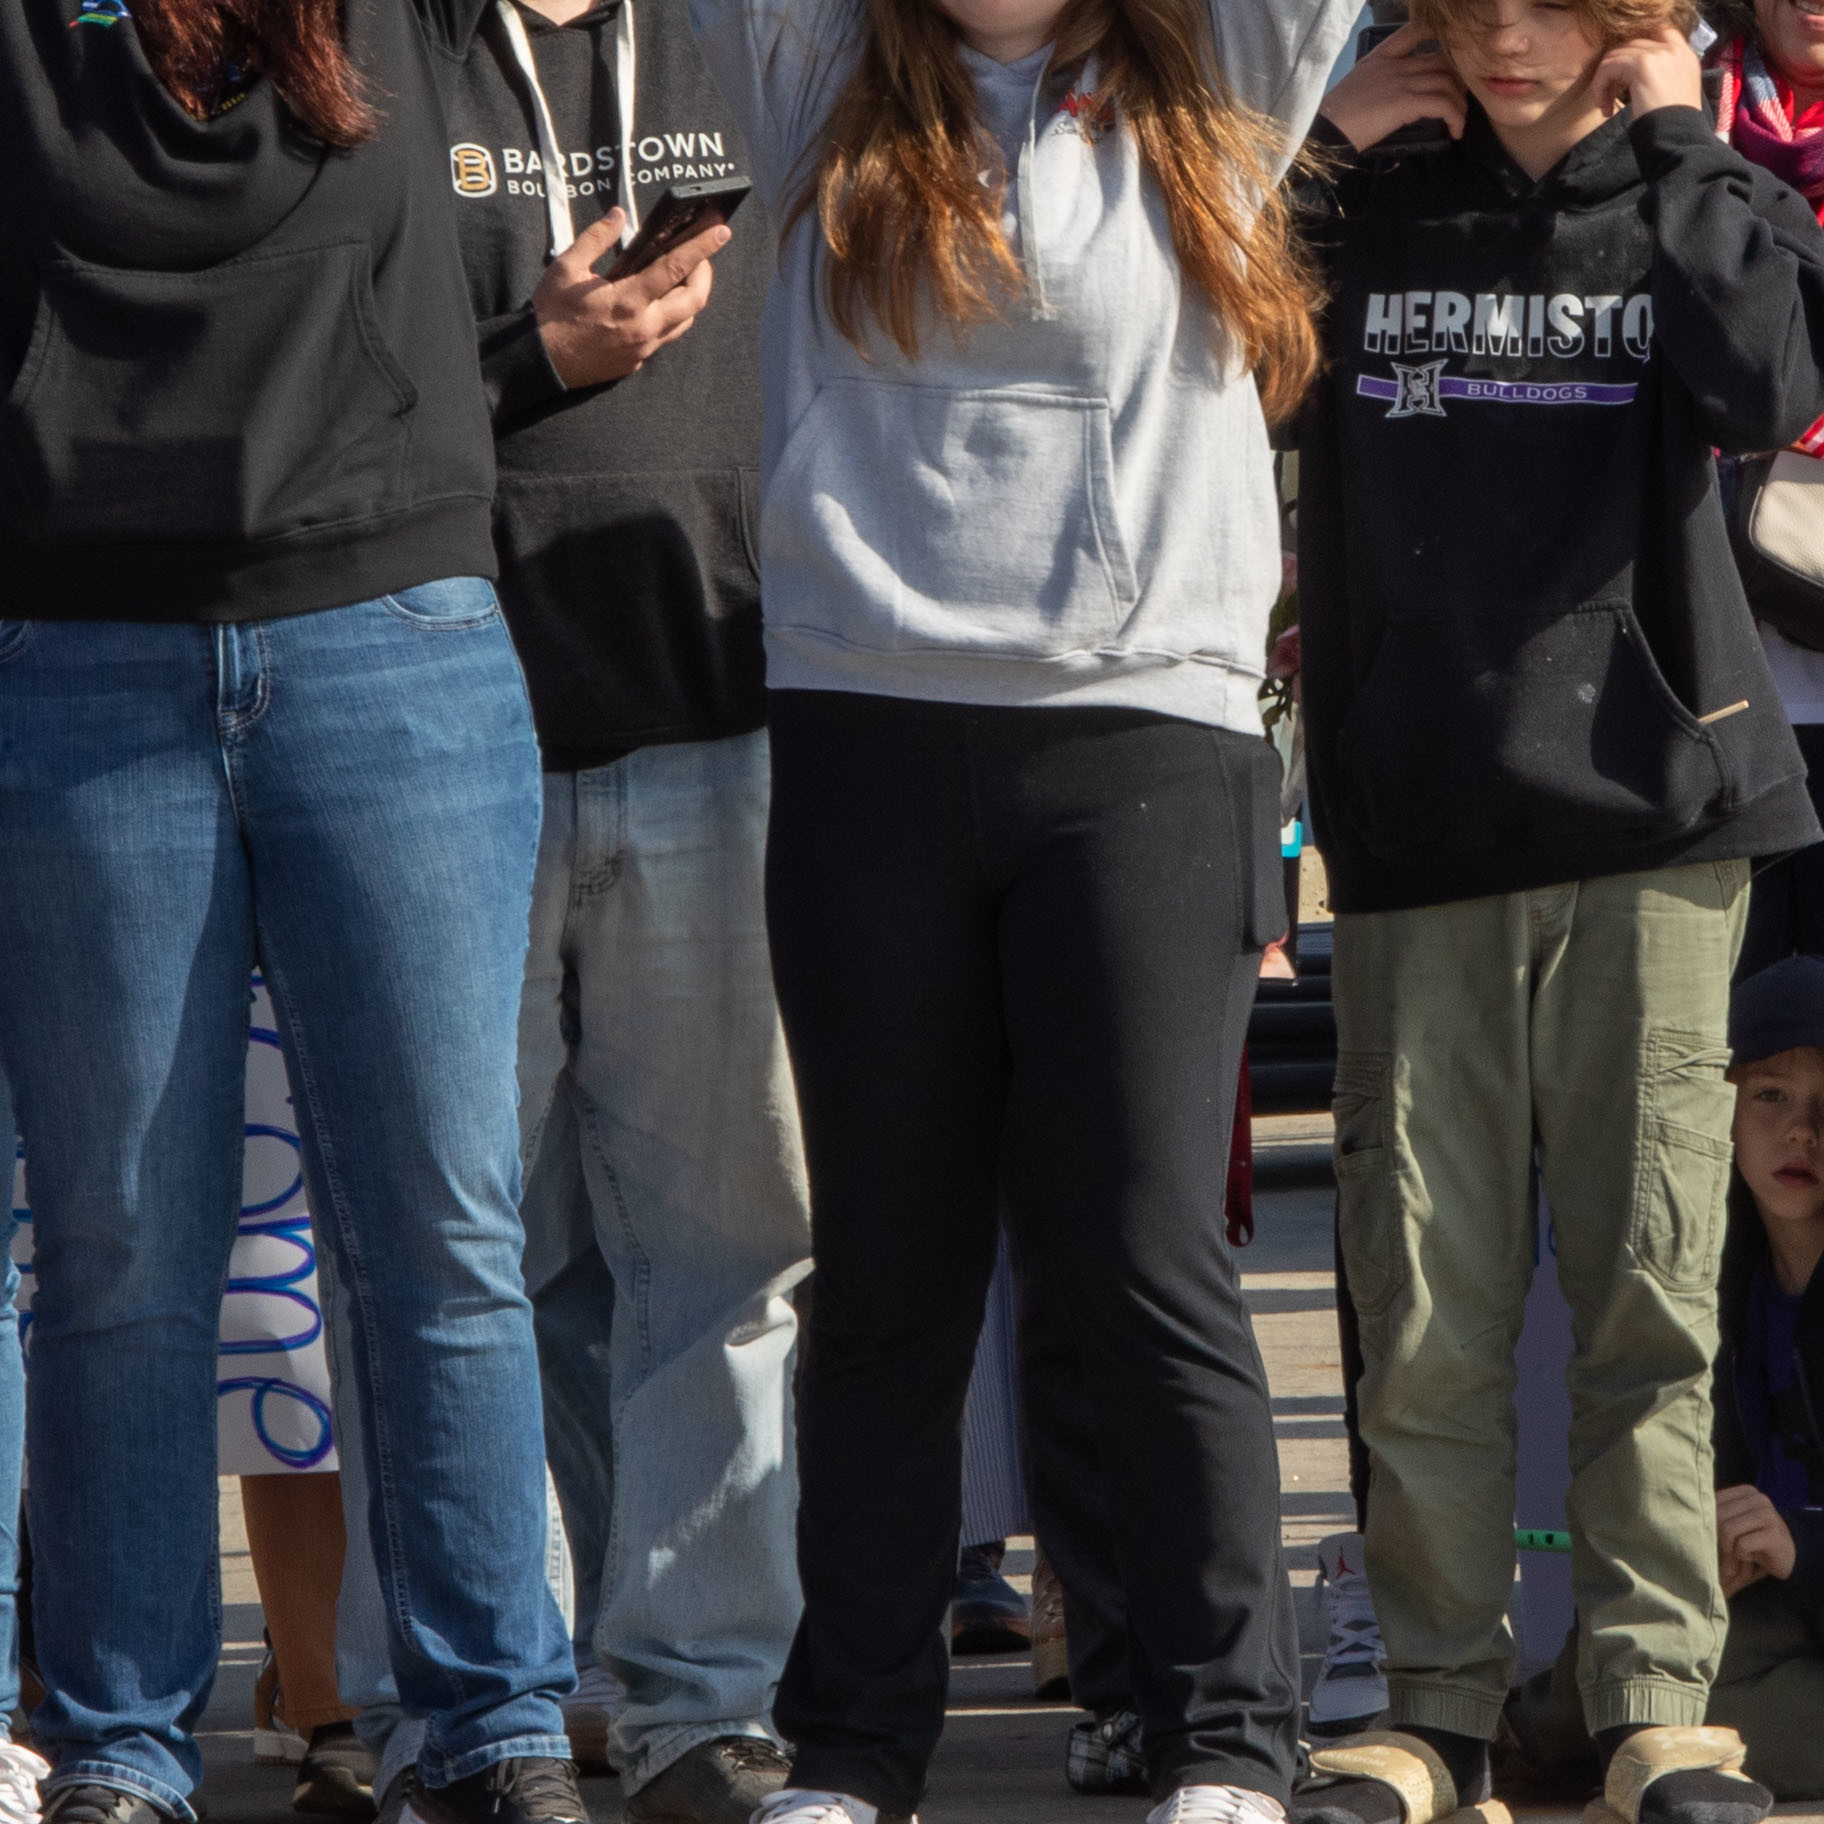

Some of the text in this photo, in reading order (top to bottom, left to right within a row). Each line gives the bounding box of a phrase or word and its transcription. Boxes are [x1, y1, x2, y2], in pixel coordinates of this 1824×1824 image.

[507, 163, 730, 199] BOUBON OMPANY
[1467, 382, 1588, 401] BULLDOGS
